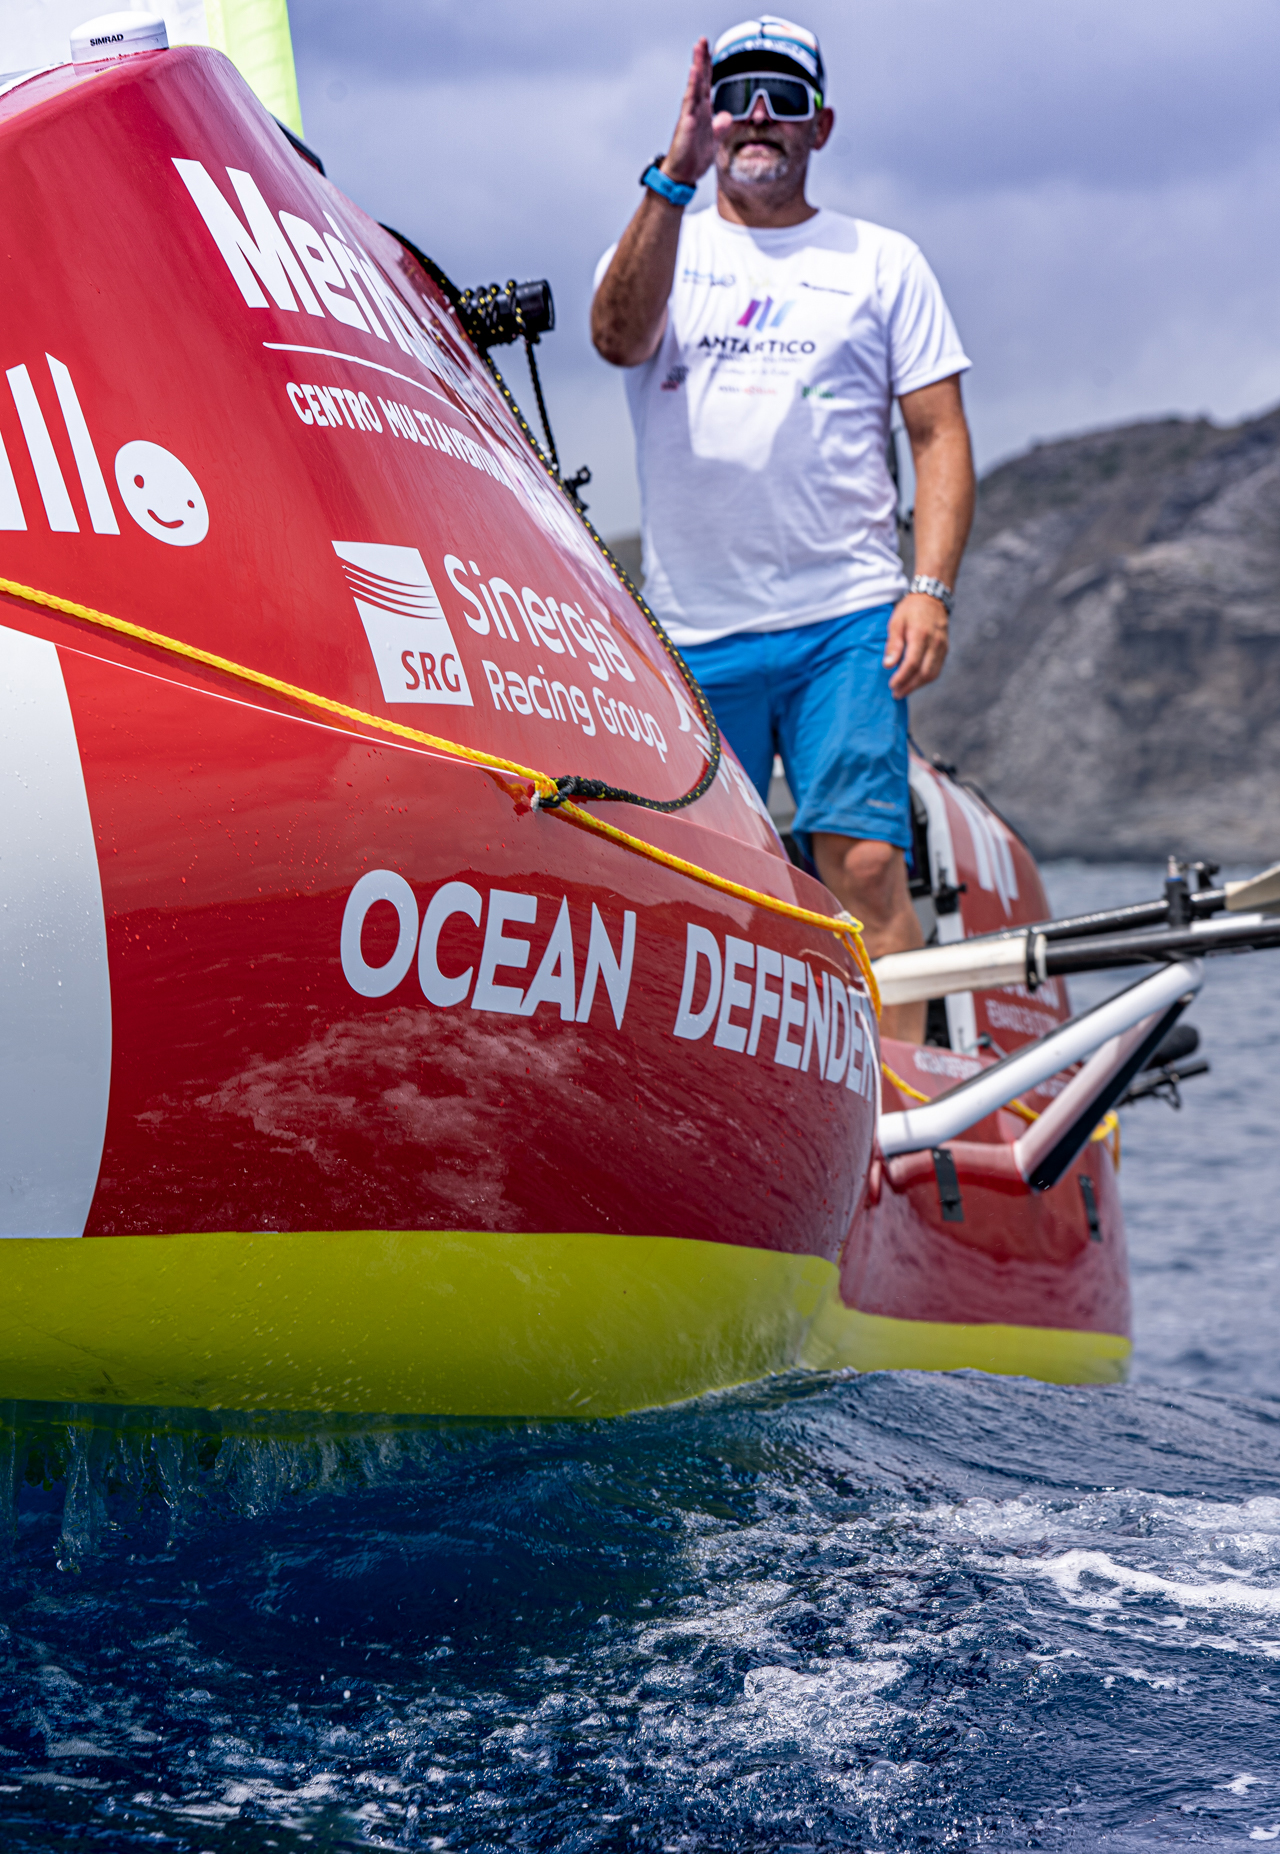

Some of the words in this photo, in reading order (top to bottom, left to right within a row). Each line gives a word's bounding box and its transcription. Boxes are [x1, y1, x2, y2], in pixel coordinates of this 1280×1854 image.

[90, 34, 124, 46] SIMRAD
[286, 382, 383, 434] CENTRO
[443, 554, 636, 683] Sinergia
[401, 651, 462, 692] SRG
[481, 659, 597, 738] Racing
[596, 686, 668, 764] Group
[340, 868, 637, 1030] OCEAN
